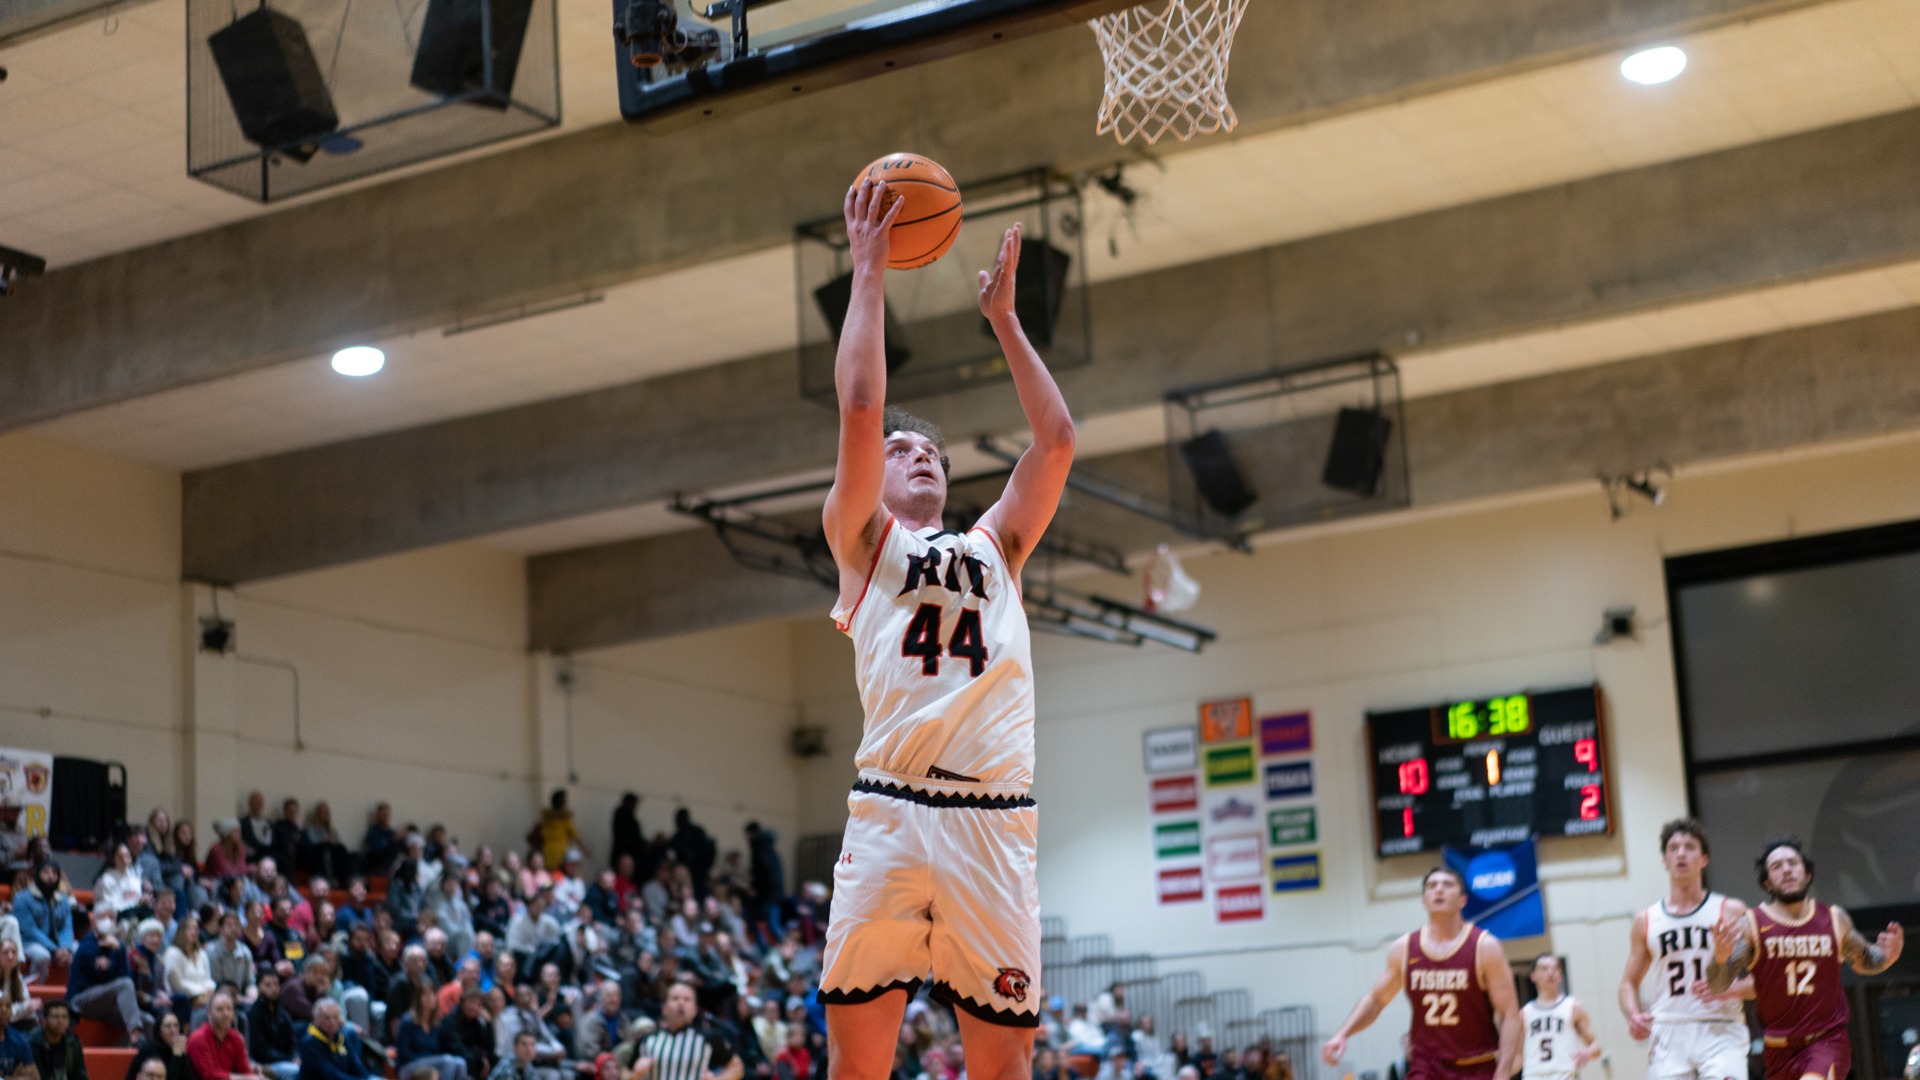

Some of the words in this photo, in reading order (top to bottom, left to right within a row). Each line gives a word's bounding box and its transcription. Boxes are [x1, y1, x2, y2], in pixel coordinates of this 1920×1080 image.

[896, 546, 991, 601] RIT
[901, 602, 989, 678] 44
[1448, 694, 1529, 738] 16:38
[1485, 748, 1501, 787] 1
[1574, 738, 1598, 772] 9
[1399, 758, 1429, 794] 10
[1580, 784, 1600, 820] 2
[1403, 807, 1415, 838] 1
[1472, 869, 1515, 890] NCAA
[1659, 925, 1713, 960] RIT
[1763, 933, 1834, 960] FISHER
[1409, 968, 1470, 992] FISHER
[1667, 957, 1703, 998] 21
[1785, 958, 1818, 996] 12
[1421, 992, 1461, 1027] 22
[1529, 1015, 1565, 1037] RIT
[1539, 1037, 1554, 1063] 5
